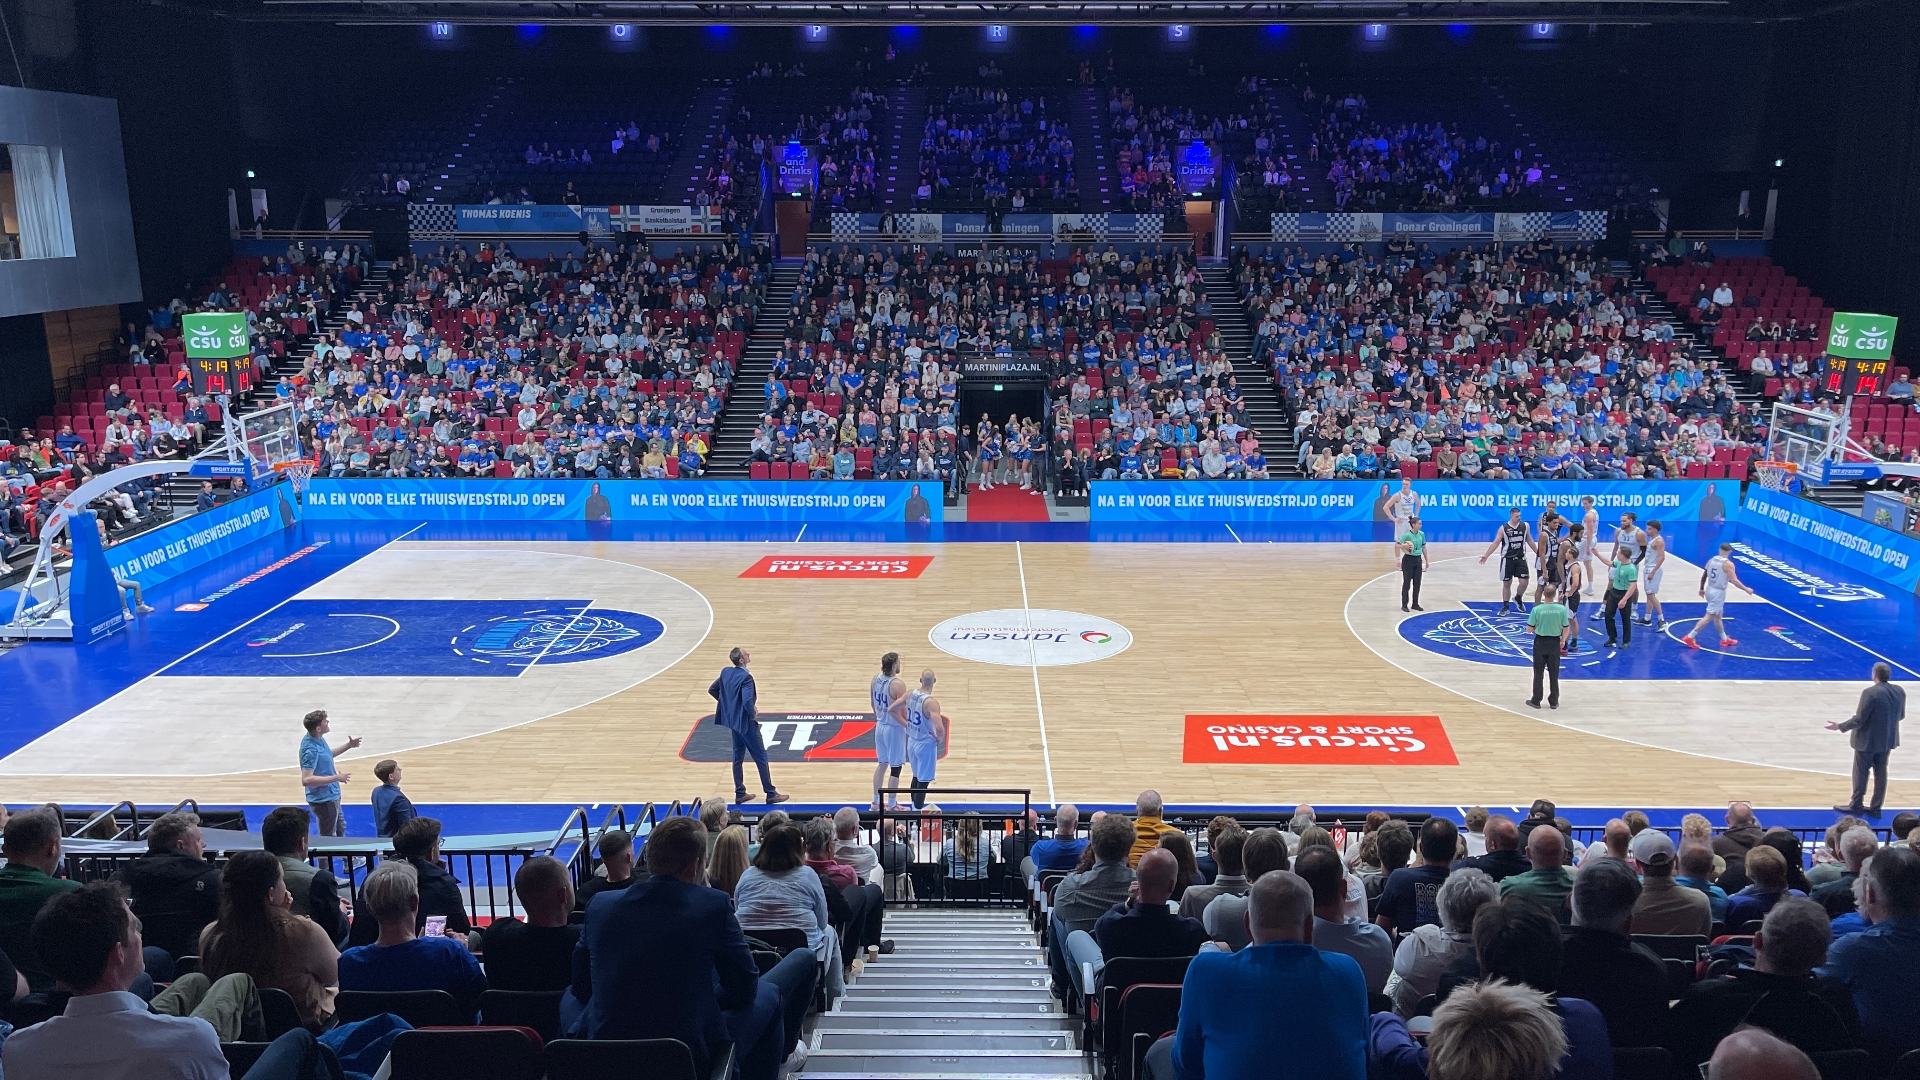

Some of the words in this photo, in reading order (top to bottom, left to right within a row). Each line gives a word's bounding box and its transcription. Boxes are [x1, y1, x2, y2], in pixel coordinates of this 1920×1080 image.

[436, 24, 448, 35] N
[782, 148, 808, 158] Fd
[1185, 148, 1211, 157] Fd
[780, 166, 812, 174] Drinks
[1182, 166, 1214, 174] Drinks
[462, 210, 497, 218] THOMAS
[500, 210, 531, 218] KOENIS
[956, 223, 985, 233] Donar
[1396, 222, 1425, 231] Donar
[1429, 222, 1481, 233] Groningen
[913, 245, 920, 253] H
[191, 337, 221, 349] CSU
[229, 335, 245, 348] CSU
[1831, 334, 1848, 348] CSU
[1855, 338, 1887, 350] CSU
[200, 360, 228, 372] 4:19
[1856, 362, 1886, 374] 4:19
[206, 374, 225, 392] 14
[239, 372, 249, 391] 14
[1828, 373, 1842, 391] 14
[1856, 376, 1879, 394] 14
[309, 492, 327, 506] NA
[330, 492, 347, 506] EN
[350, 492, 382, 506] VOOR
[386, 492, 416, 506] ELKE
[419, 492, 529, 506] THUISWEDSTRIJD
[532, 492, 565, 506] OPEN
[630, 494, 649, 507] NA
[652, 494, 668, 507] EN
[671, 494, 704, 507] VOOR
[708, 494, 738, 507] ELKE
[741, 494, 850, 507] THUISWEDSTRIJD
[853, 494, 885, 507] OPEN
[1098, 494, 1115, 507] NA
[1119, 494, 1135, 507] EN
[1138, 494, 1171, 507] VOOR
[1175, 494, 1204, 507] ELKE
[1208, 494, 1317, 507] THUISWEDSTRIJD
[1320, 494, 1354, 507] OPEN
[1420, 493, 1438, 507] NA
[1441, 493, 1457, 507] EN
[1461, 493, 1494, 507] VOOR
[1498, 493, 1528, 507] ELKE
[1646, 493, 1680, 507] OPEN
[1746, 498, 1758, 512] NA
[1758, 500, 1768, 514] EN
[1770, 505, 1790, 523] VOOR
[1790, 513, 1810, 532] ELKE
[1810, 521, 1883, 558] THUISWEDSTRIJD
[1883, 548, 1909, 570] OPEN
[114, 564, 128, 581] NA
[129, 559, 140, 574] EN
[141, 550, 166, 568] VOOR
[167, 543, 188, 560] ELKE
[187, 519, 251, 552] THUISWEDSTRIJD
[252, 506, 270, 527] OPEN
[768, 565, 909, 573] Circus.nl
[1710, 568, 1717, 579] 5
[950, 632, 1071, 643] Jansen
[875, 691, 888, 707] 44
[908, 708, 921, 725] 13
[1206, 726, 1303, 734] CASINO
[1309, 726, 1331, 734] &
[1337, 726, 1414, 734] SPORT
[1212, 735, 1426, 752] Circus.nl
[1048, 1039, 1058, 1047] 7
